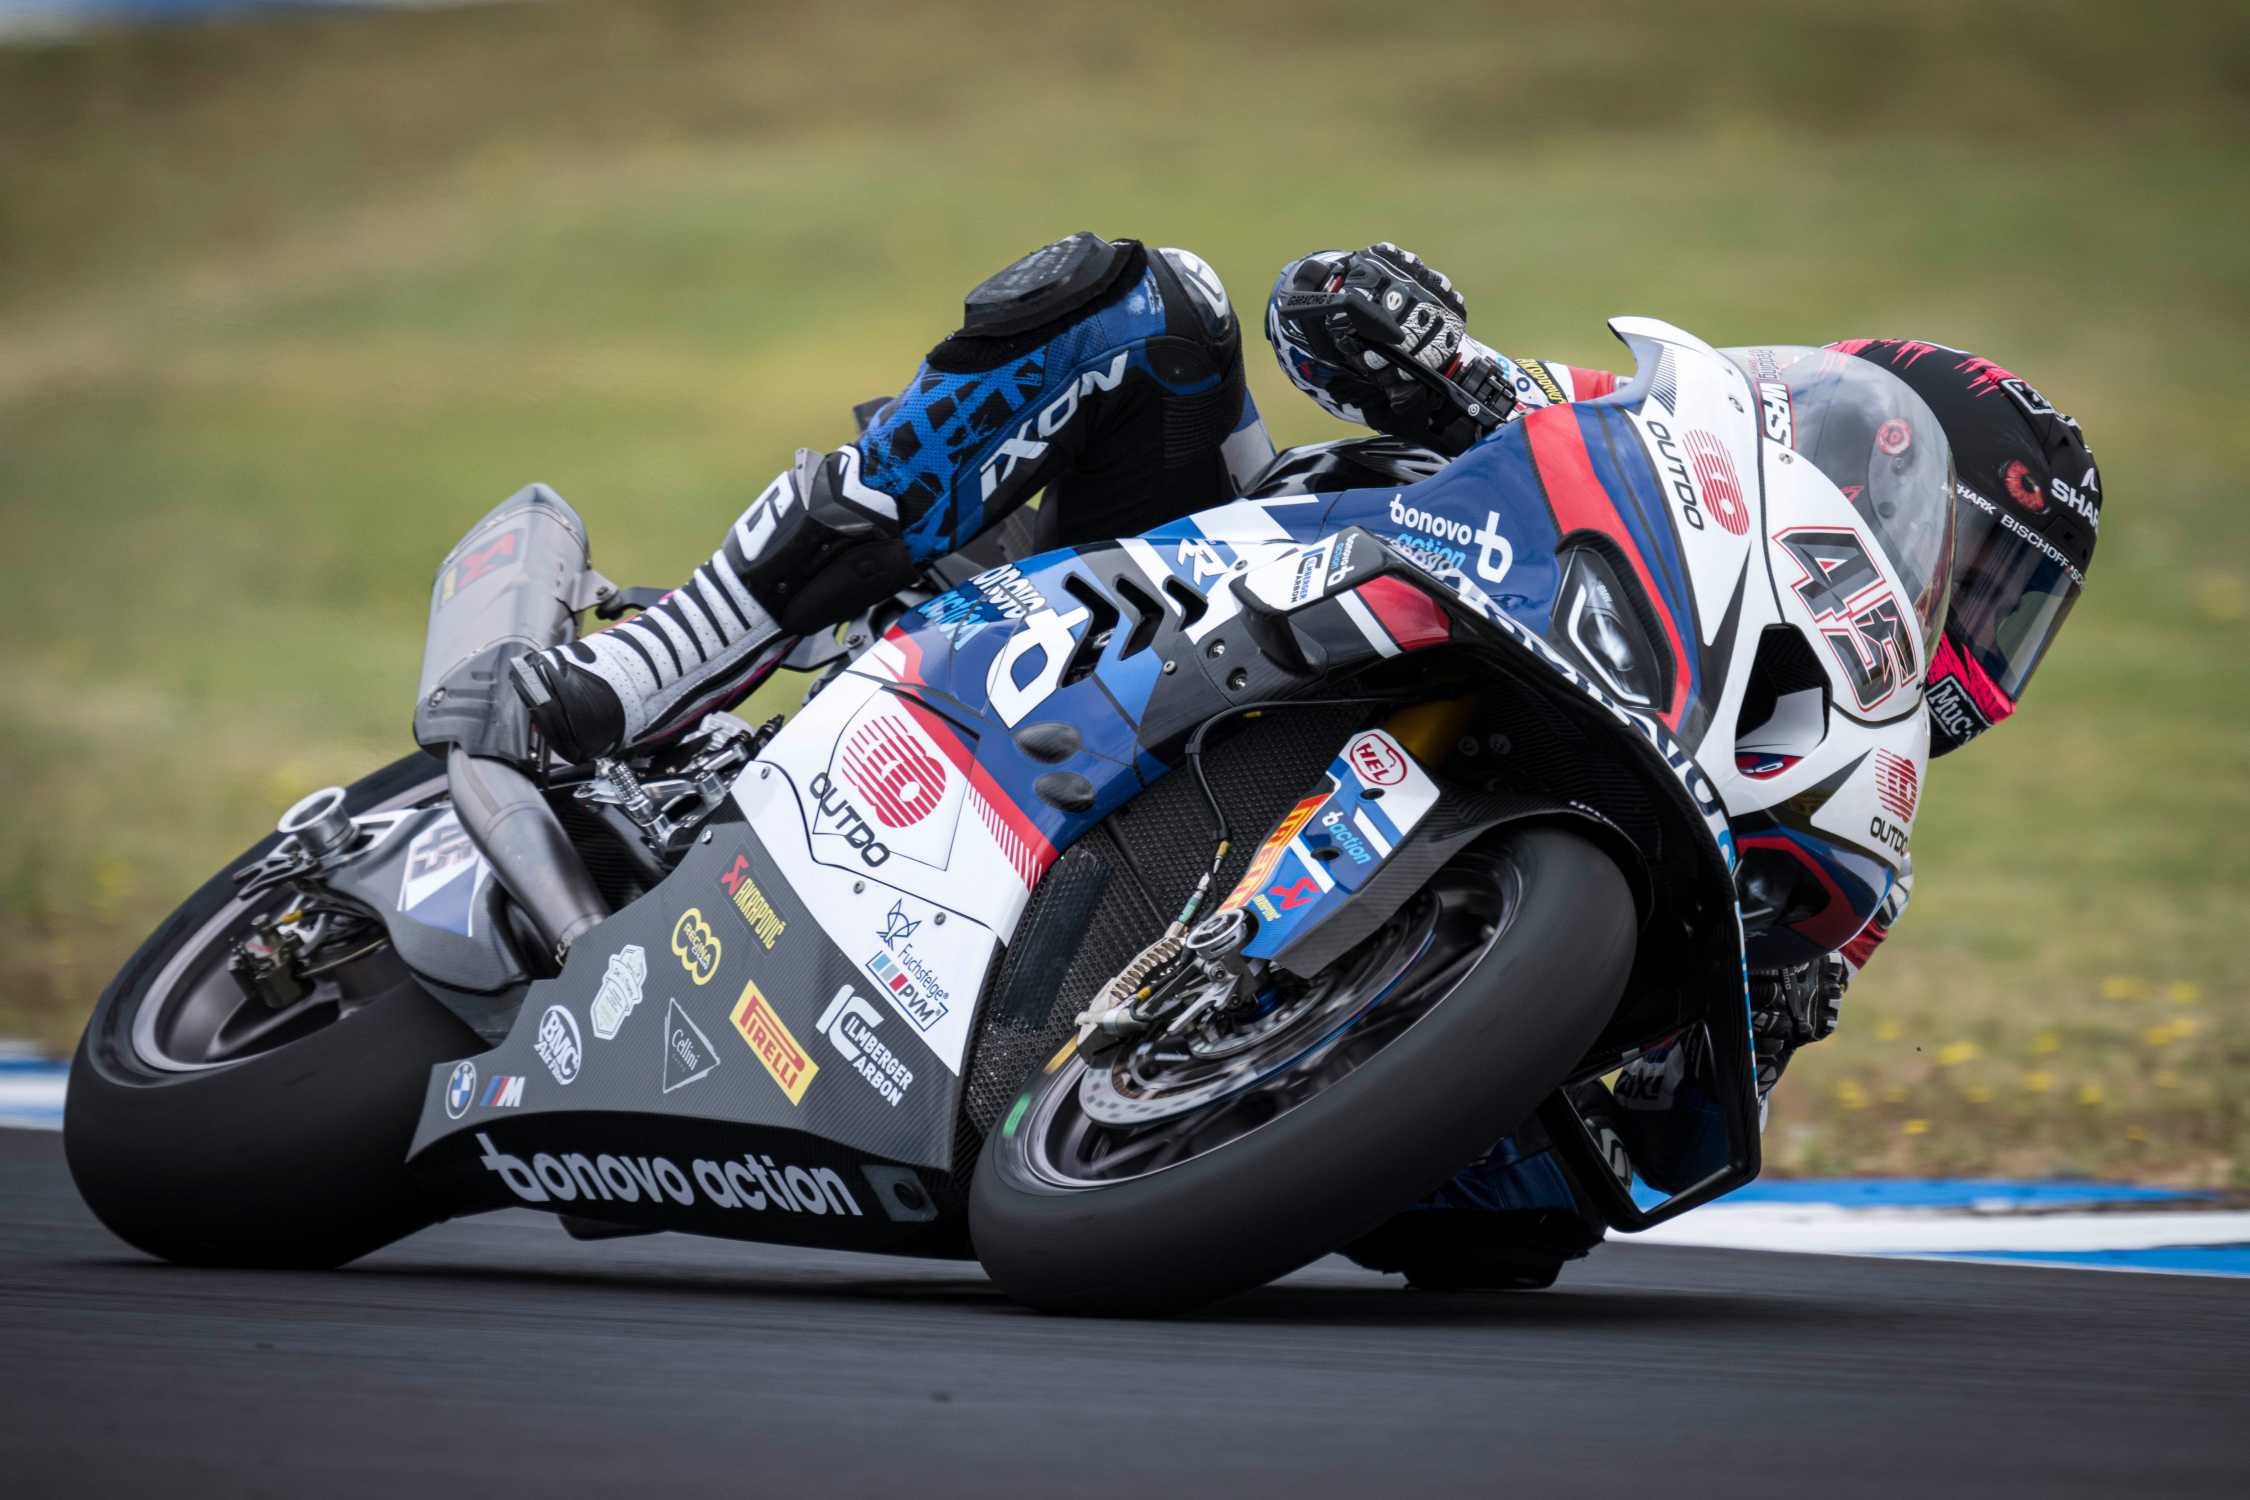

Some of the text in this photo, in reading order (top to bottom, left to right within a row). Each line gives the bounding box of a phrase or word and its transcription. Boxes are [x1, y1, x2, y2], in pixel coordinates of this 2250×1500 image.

[979, 349, 1131, 502] IXON
[1759, 382, 1792, 449] WRS
[1646, 420, 1705, 532] OUTDO
[1388, 493, 1473, 546] bonovo
[2000, 513, 2070, 569] BISCHOFF
[1772, 526, 1919, 712] 45
[1355, 742, 1391, 782] HEL
[809, 771, 891, 868] OUTDO
[1328, 821, 1371, 865] action
[542, 1010, 578, 1076] BMC
[671, 1029, 701, 1071] Cellini
[739, 995, 806, 1090] PIRELLI
[843, 1015, 914, 1092] ILMBERGER
[475, 1132, 864, 1217] bonovo action
